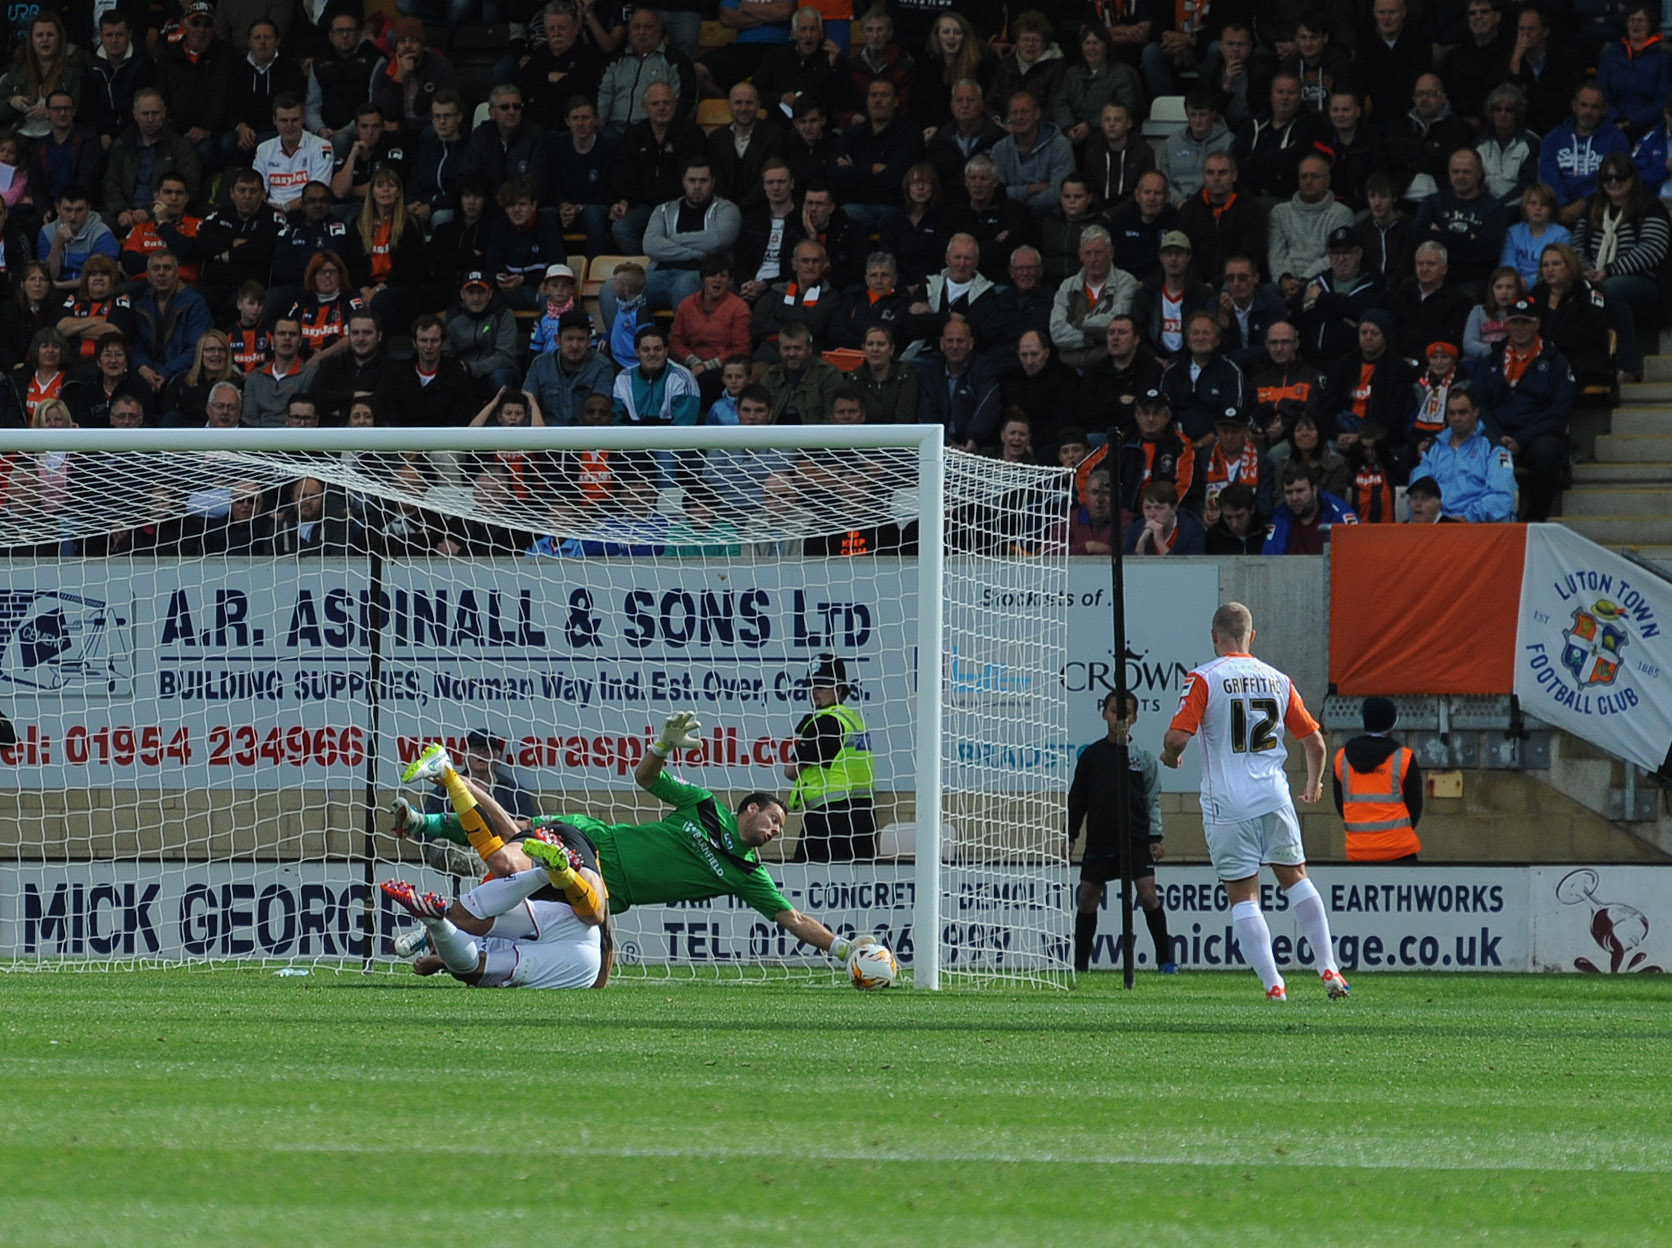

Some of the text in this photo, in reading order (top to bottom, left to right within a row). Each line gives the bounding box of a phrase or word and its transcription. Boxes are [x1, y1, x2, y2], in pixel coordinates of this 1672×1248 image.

[161, 588, 871, 648] A.R. ASPINALL & SONS LTD
[1533, 611, 1551, 625] EST
[1554, 571, 1660, 639] LUTON TOWN
[160, 670, 283, 700] BUILDING
[434, 671, 534, 700] Norman
[541, 671, 593, 708] Way
[1223, 678, 1281, 694] GRIFFITHS
[1526, 643, 1639, 716] FOOTBALL CLUB
[66, 725, 192, 766] 01954
[208, 725, 364, 768] 234966
[1230, 698, 1279, 753] 12
[25, 883, 161, 954] MICK
[1331, 884, 1504, 912] EARTHWORKS
[663, 922, 741, 961] TEL.
